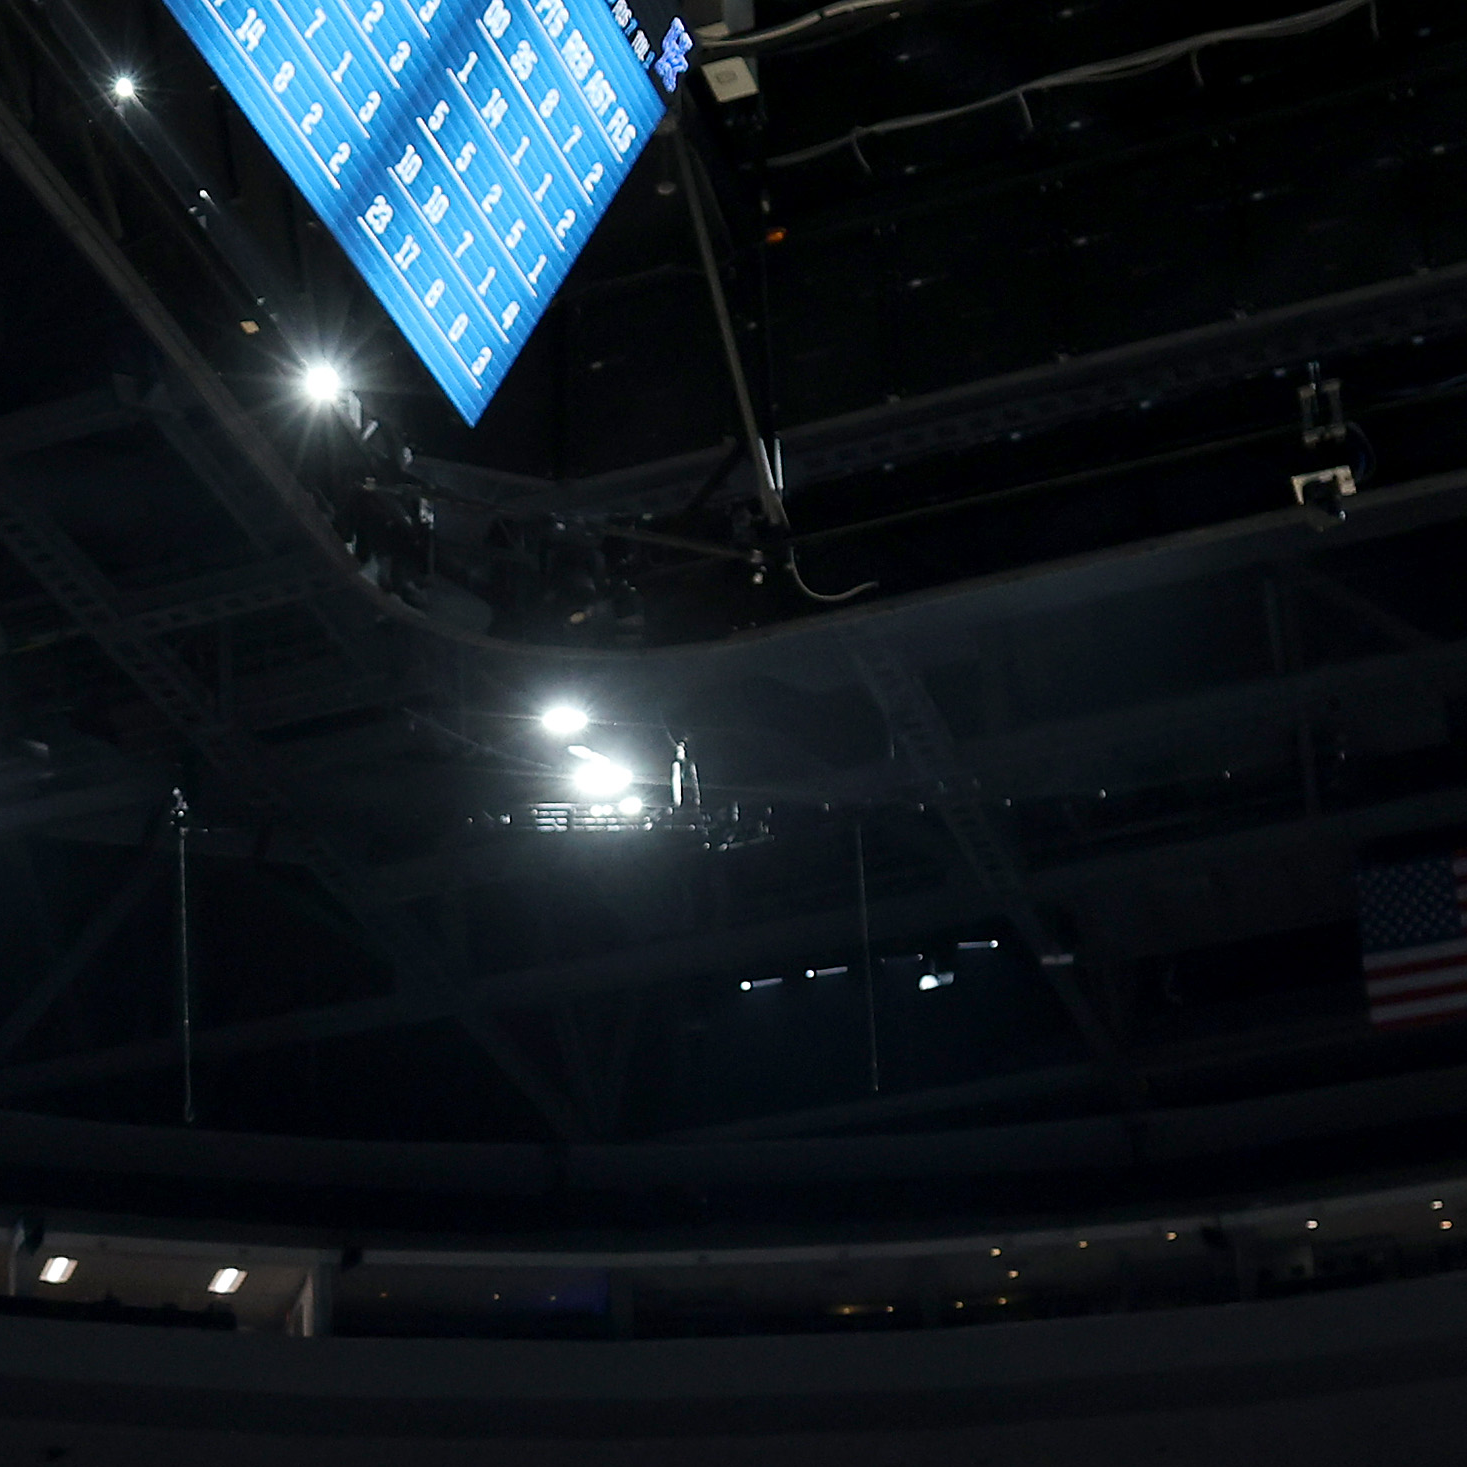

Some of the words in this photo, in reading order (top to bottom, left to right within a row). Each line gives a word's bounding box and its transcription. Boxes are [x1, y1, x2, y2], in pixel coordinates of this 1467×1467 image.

[304, 7, 327, 39] 7
[331, 50, 354, 83] 1
[358, 91, 381, 123] 3
[388, 41, 411, 72] 3
[562, 29, 595, 80] REB
[235, 8, 267, 51] 14
[273, 61, 295, 93] 8
[301, 102, 324, 135] 2
[328, 142, 351, 174] 2
[457, 51, 478, 83] 1
[481, 88, 509, 130] 14
[510, 136, 531, 166] 1
[533, 173, 553, 203] 1
[555, 209, 576, 238] 2
[563, 125, 583, 153] 7
[583, 162, 604, 192] 2
[427, 100, 450, 131] 5
[455, 141, 477, 172] 5
[481, 184, 503, 214] 2
[505, 219, 526, 249] 5
[527, 254, 547, 284] 1
[393, 235, 421, 270] 17
[454, 230, 475, 258] 7
[477, 266, 497, 296] 1
